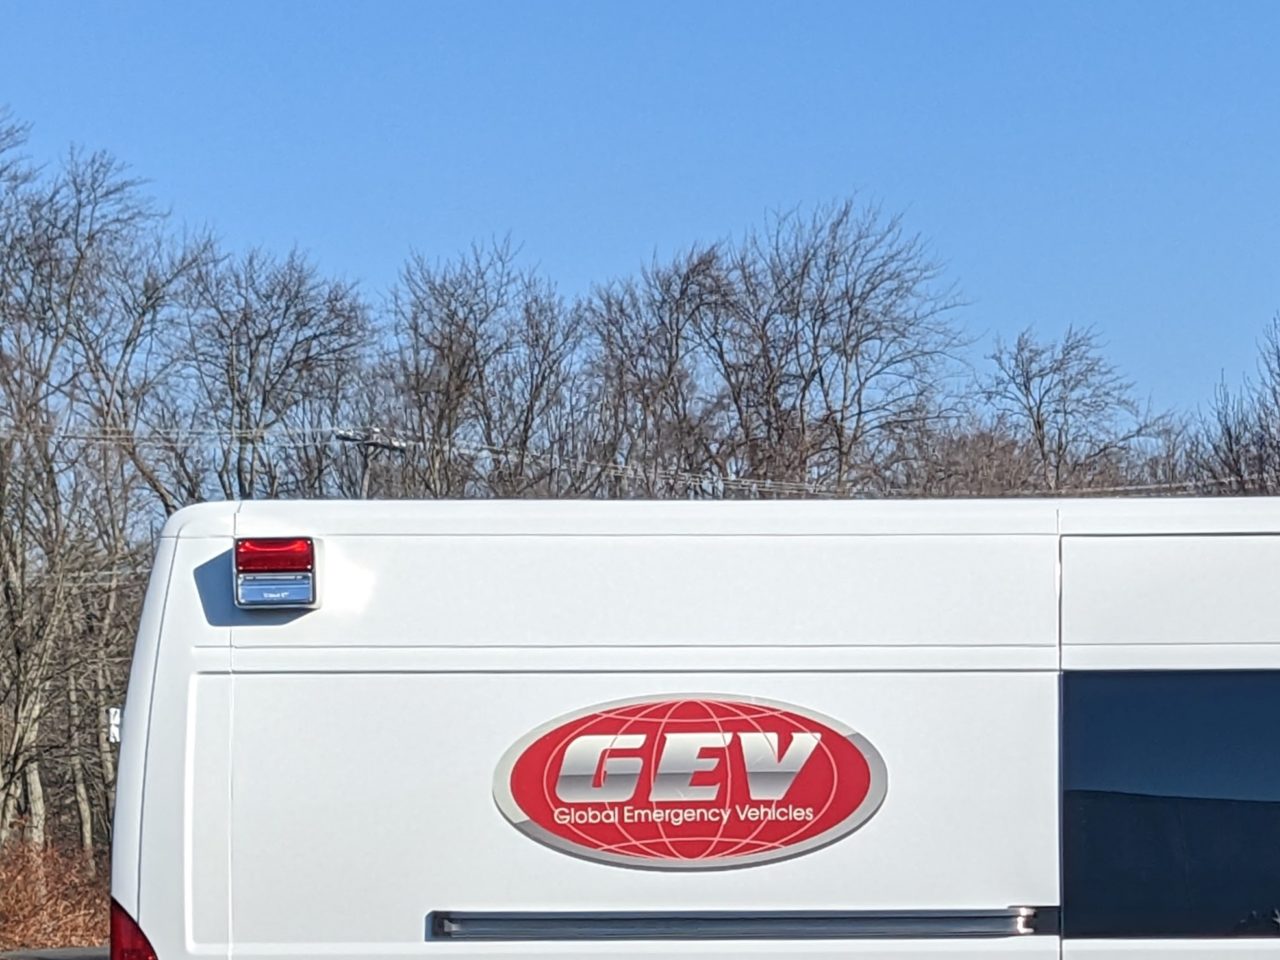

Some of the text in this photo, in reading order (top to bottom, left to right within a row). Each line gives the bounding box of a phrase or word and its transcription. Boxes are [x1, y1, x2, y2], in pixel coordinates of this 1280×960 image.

[555, 732, 822, 803] GEV
[553, 803, 814, 826] Global Emergency Vehicles
